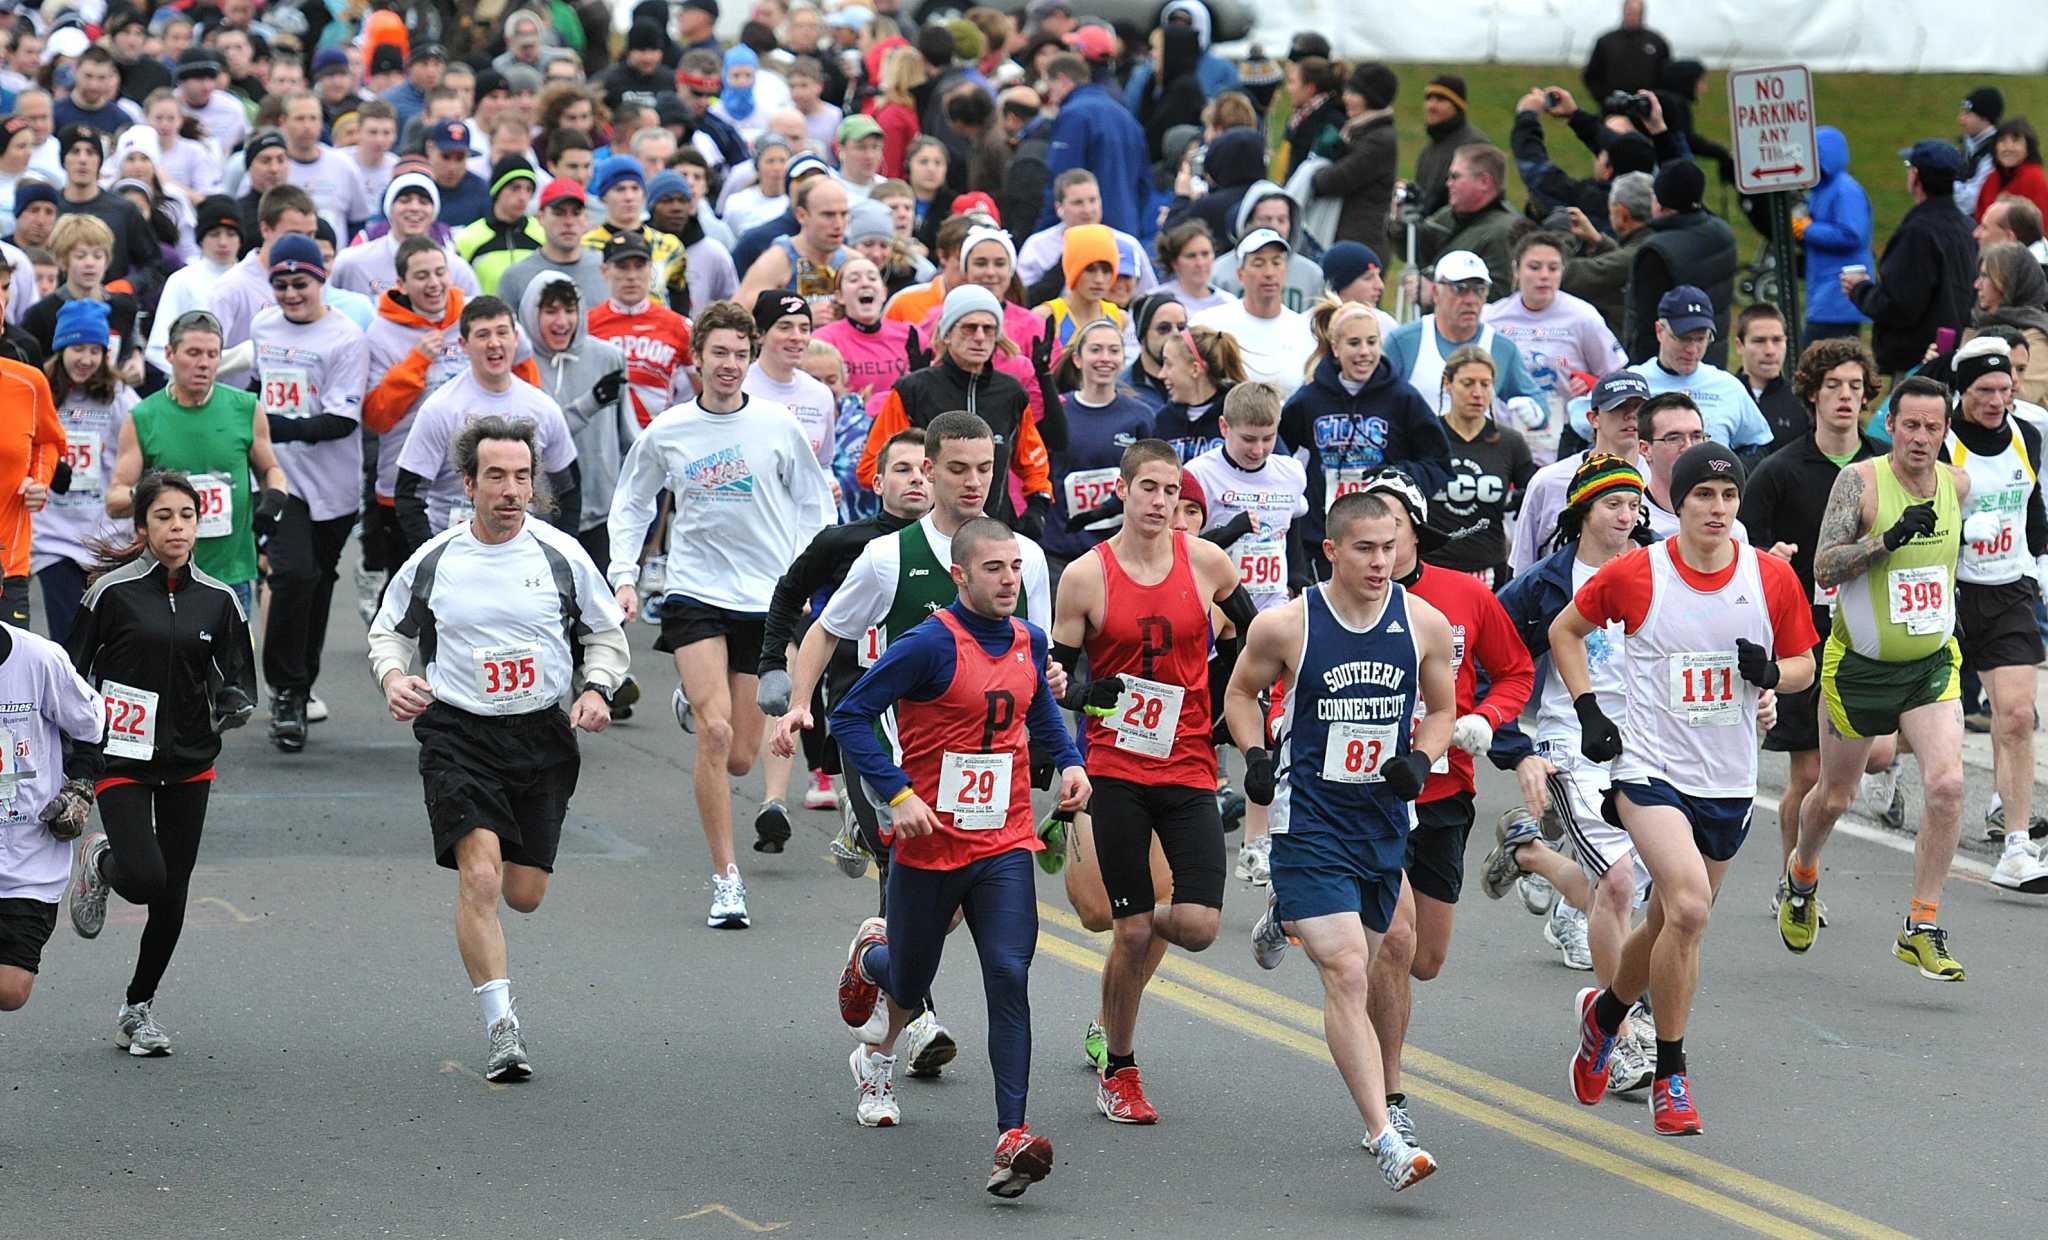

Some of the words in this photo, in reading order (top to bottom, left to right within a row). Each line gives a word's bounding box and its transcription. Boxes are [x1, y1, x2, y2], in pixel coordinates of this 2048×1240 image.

[1755, 77, 1784, 101] NO
[1738, 99, 1806, 128] PARKING
[1760, 127, 1789, 144] ANY
[266, 382, 300, 408] 634
[1239, 556, 1281, 584] 596
[1897, 581, 1943, 614] 398
[1135, 615, 1174, 681] P
[484, 657, 536, 694] 335
[1323, 661, 1406, 694] SOUTHERN
[1682, 667, 1733, 704] 111
[104, 696, 147, 737] 522
[985, 689, 1015, 754] P
[1123, 692, 1164, 731] 28
[1317, 693, 1407, 721] CONNECTICUT
[1344, 740, 1383, 773] 83
[958, 769, 995, 805] 29
